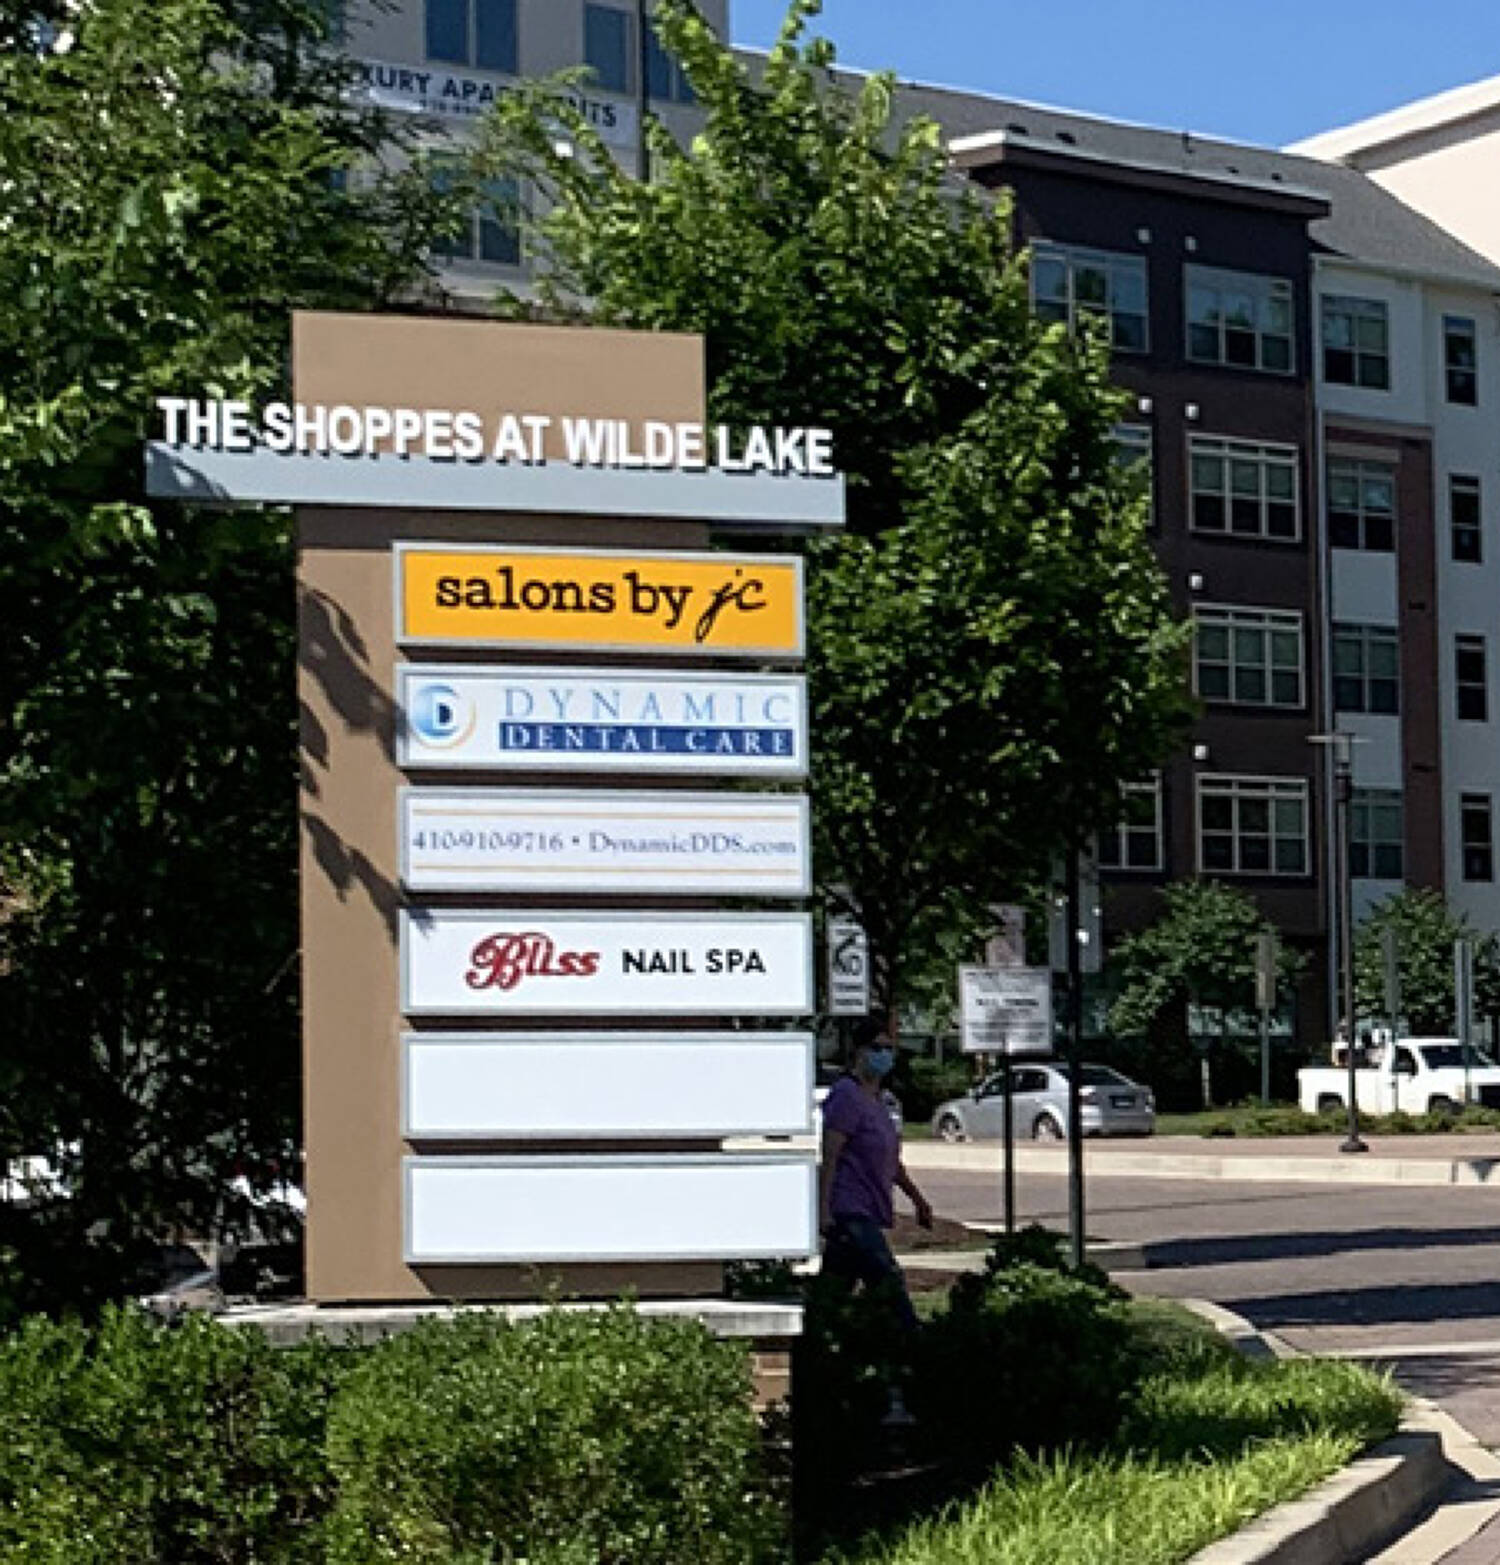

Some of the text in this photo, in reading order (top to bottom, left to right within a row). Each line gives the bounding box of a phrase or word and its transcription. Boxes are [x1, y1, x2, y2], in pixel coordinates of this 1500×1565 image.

[157, 398, 834, 474] THE SHOPPES AT WILDE LAKE
[436, 565, 767, 642] salons by jc
[504, 688, 792, 723] DYNAMIC
[506, 725, 788, 754] DENTAL CARE
[412, 831, 797, 857] 410-910-9716 DynamicDDS.com
[465, 932, 767, 991] Bliss NAIL SPA
